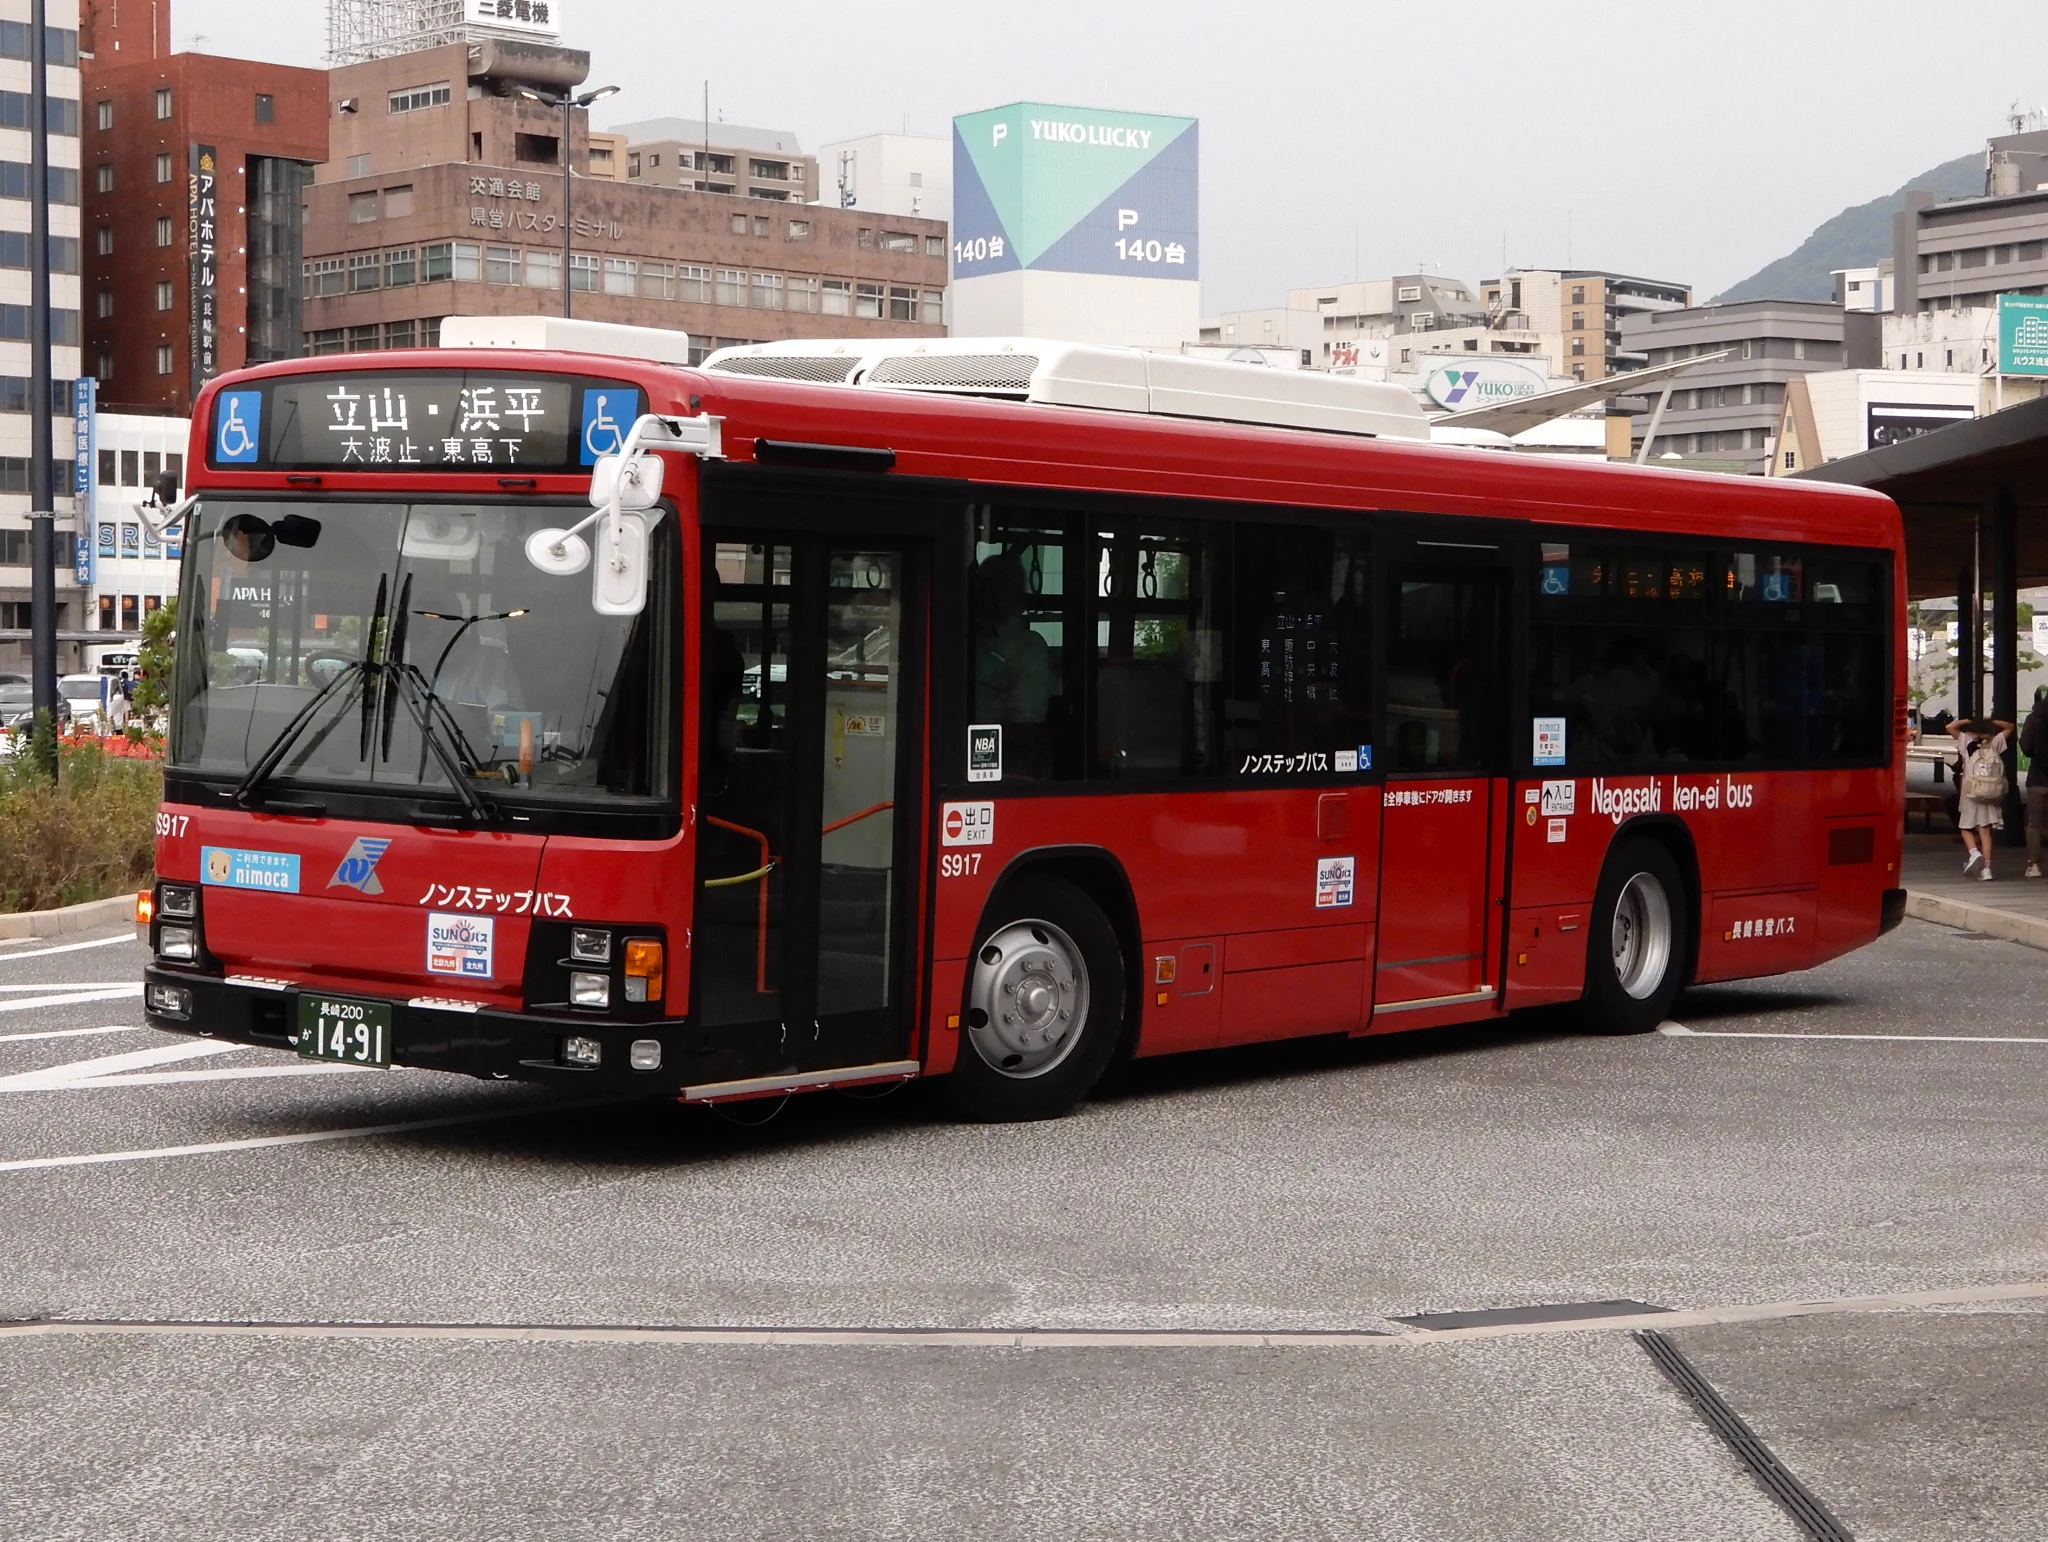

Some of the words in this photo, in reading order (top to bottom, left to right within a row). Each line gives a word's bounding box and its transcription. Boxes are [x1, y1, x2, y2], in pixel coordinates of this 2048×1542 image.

[993, 123, 1008, 147] P
[1030, 119, 1087, 144] YUKO
[1089, 126, 1152, 149] LUCKY
[470, 176, 541, 201] 交通会館
[200, 174, 215, 287] アパホテル
[470, 206, 623, 240] 県営バスターミナル
[1118, 209, 1138, 231] P
[189, 207, 198, 260] HOTEL
[954, 236, 1005, 263] 140台
[1115, 238, 1187, 264] 140台
[1475, 382, 1514, 396] YUKO
[326, 385, 545, 433] 立山・浜平
[340, 436, 523, 464] 大波止・東高下
[232, 587, 258, 601] APA
[974, 737, 995, 751] NBA
[1240, 752, 1328, 774] ノンステップバス
[1554, 785, 1572, 800] 入口
[1591, 776, 1661, 825] Nagasaki
[1673, 775, 1719, 811] ken-ei
[1726, 773, 1752, 808] bus
[156, 811, 190, 838] S917
[965, 807, 991, 826] 出口
[967, 829, 987, 840] EXIT
[236, 864, 289, 888] nimoca
[941, 853, 982, 877] S917
[419, 883, 573, 918] ノンステップバス
[432, 927, 488, 944] SUNQパス
[1732, 917, 1795, 940] 長崎県営バス
[317, 1017, 382, 1063] 14-91
